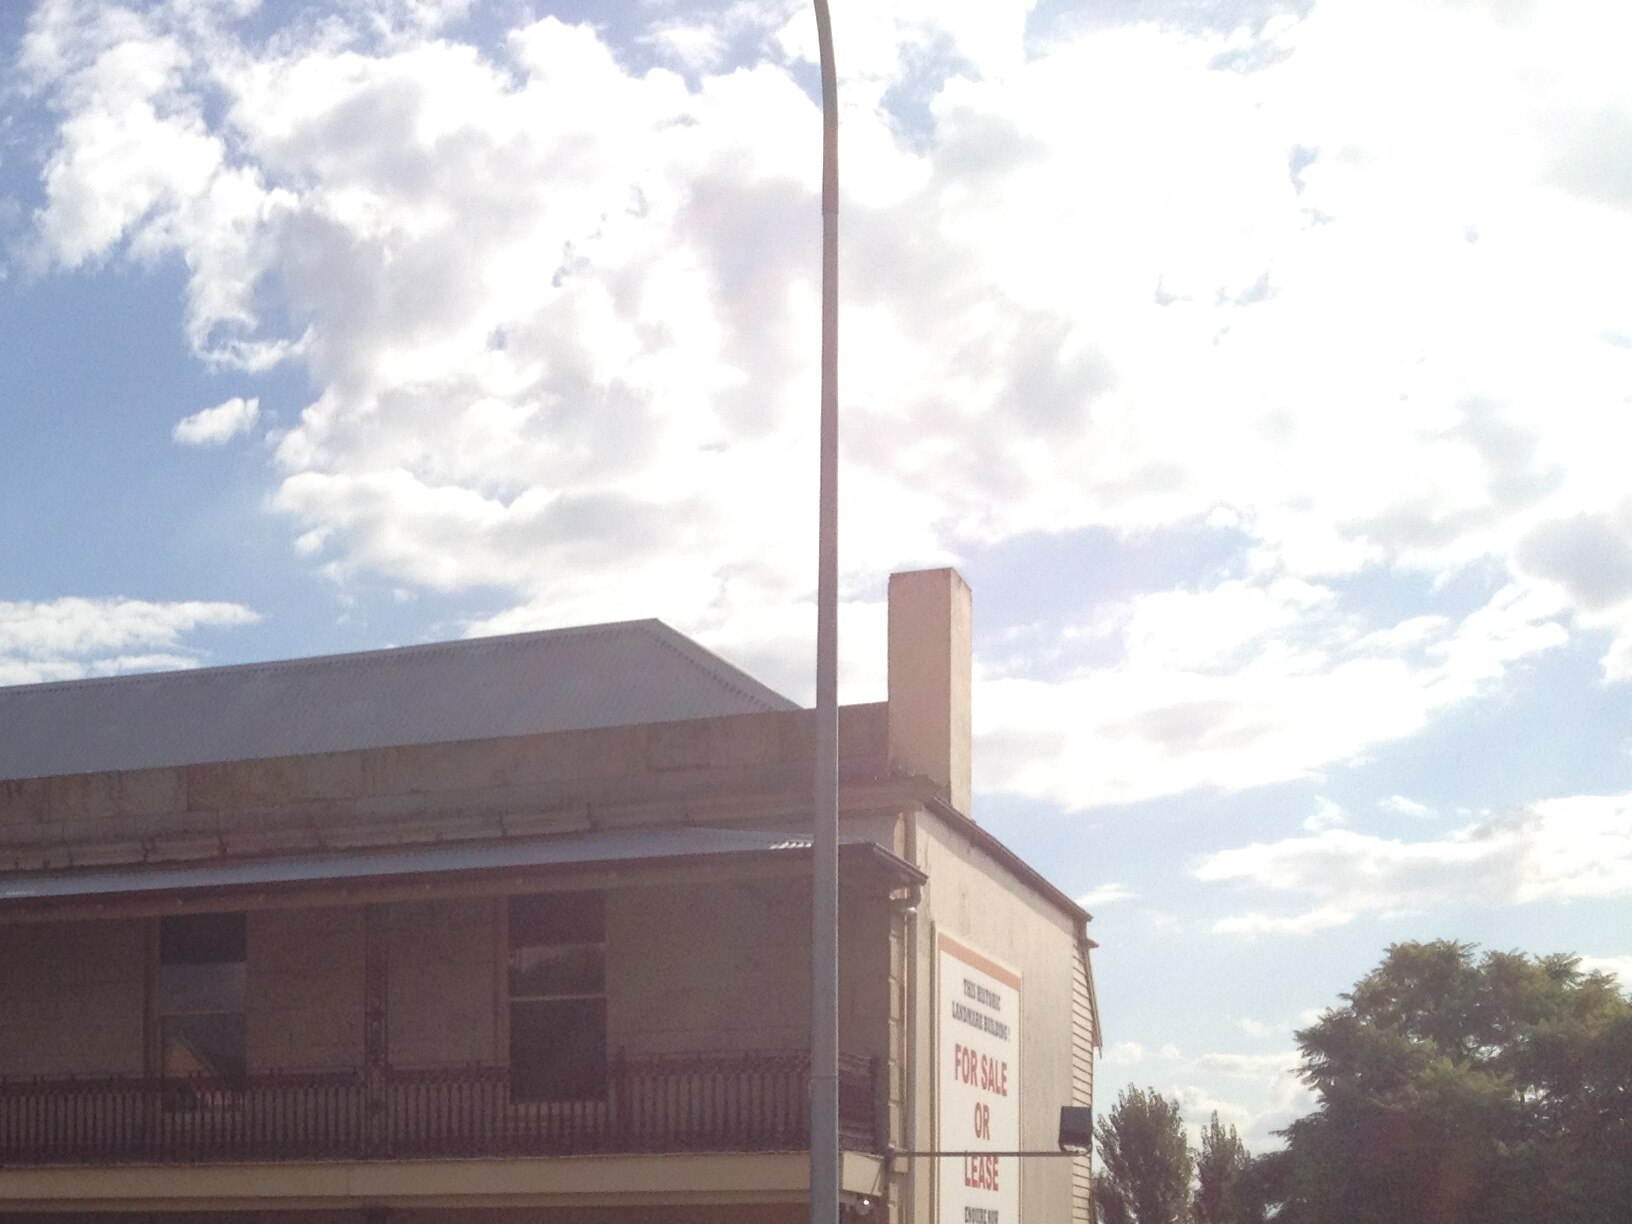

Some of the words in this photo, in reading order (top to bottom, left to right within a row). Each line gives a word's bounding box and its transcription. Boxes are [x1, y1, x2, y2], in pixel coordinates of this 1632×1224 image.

[952, 1001, 983, 1031] LANDMARK
[955, 1043, 978, 1087] FOR
[981, 1053, 1008, 1097] SALE
[974, 1101, 991, 1141] OR
[964, 1150, 999, 1192] LEASE
